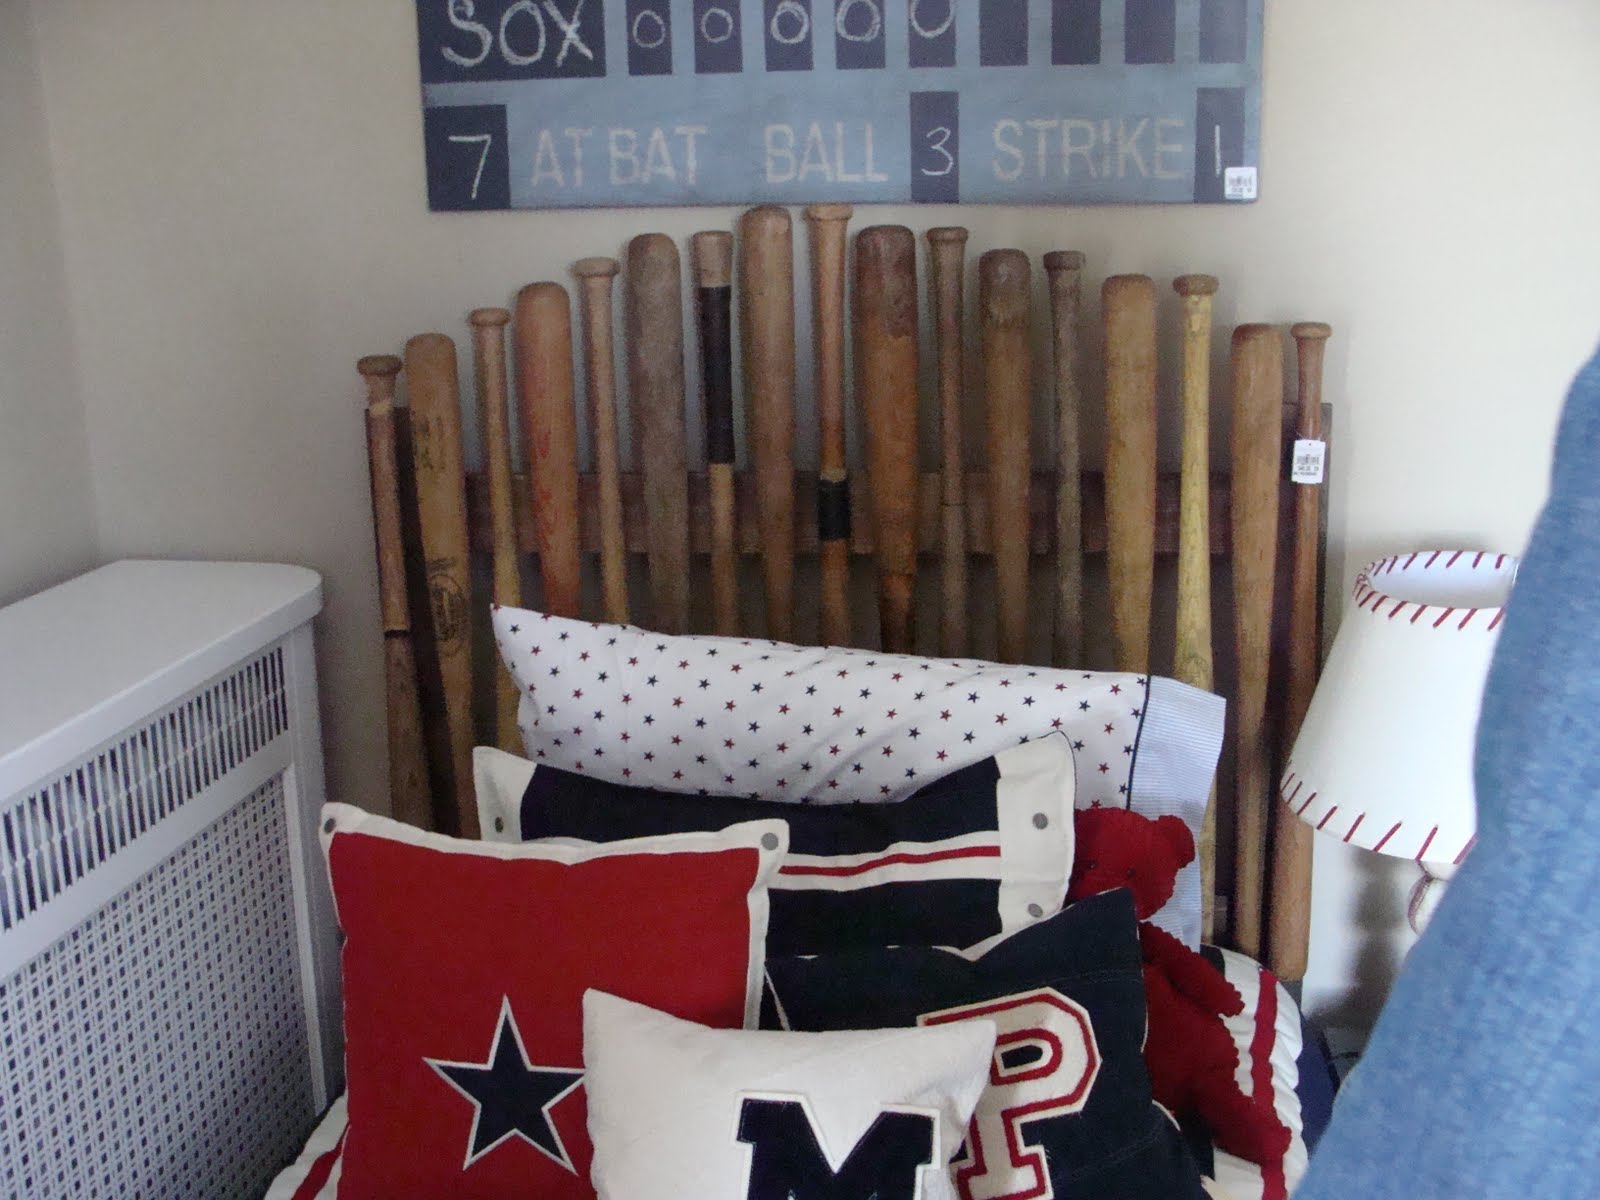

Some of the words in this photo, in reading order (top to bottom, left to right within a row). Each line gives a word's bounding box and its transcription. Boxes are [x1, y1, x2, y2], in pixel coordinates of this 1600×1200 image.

[441, 0, 594, 67] SOX
[447, 133, 492, 199] 7
[530, 128, 593, 189] AT
[608, 125, 707, 187] BAT
[764, 120, 889, 184] BALL
[921, 126, 955, 177] 3
[991, 118, 1186, 183] STRIKE
[915, 986, 1102, 1200] P
[735, 1089, 941, 1200] M
